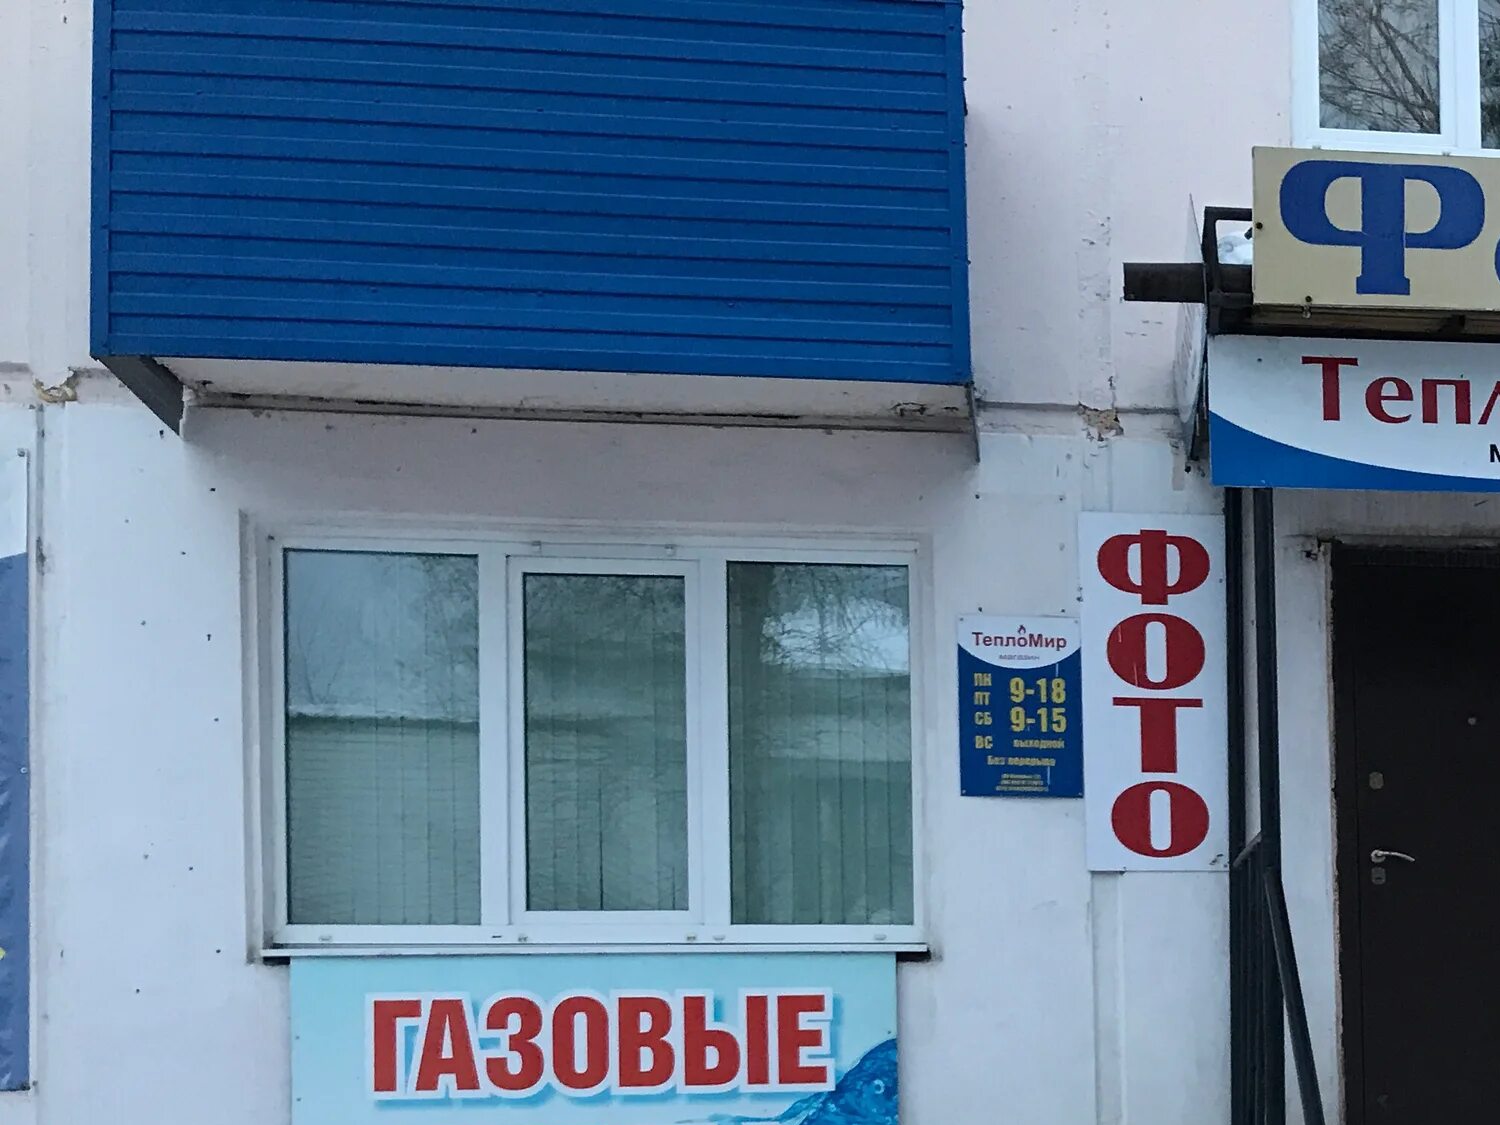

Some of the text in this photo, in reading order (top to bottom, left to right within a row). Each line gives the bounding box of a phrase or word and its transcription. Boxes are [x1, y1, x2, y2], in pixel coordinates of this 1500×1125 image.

[972, 630, 1067, 651] ТеплоМир
[974, 673, 992, 687] ПН
[1009, 677, 1066, 704] 9-18
[974, 691, 991, 705] ПТ
[1096, 529, 1211, 858] ФОТО
[974, 706, 1067, 733] СБ 9-15
[975, 735, 993, 749] ВС
[372, 994, 829, 1093] ГАЗОВЫЕ
